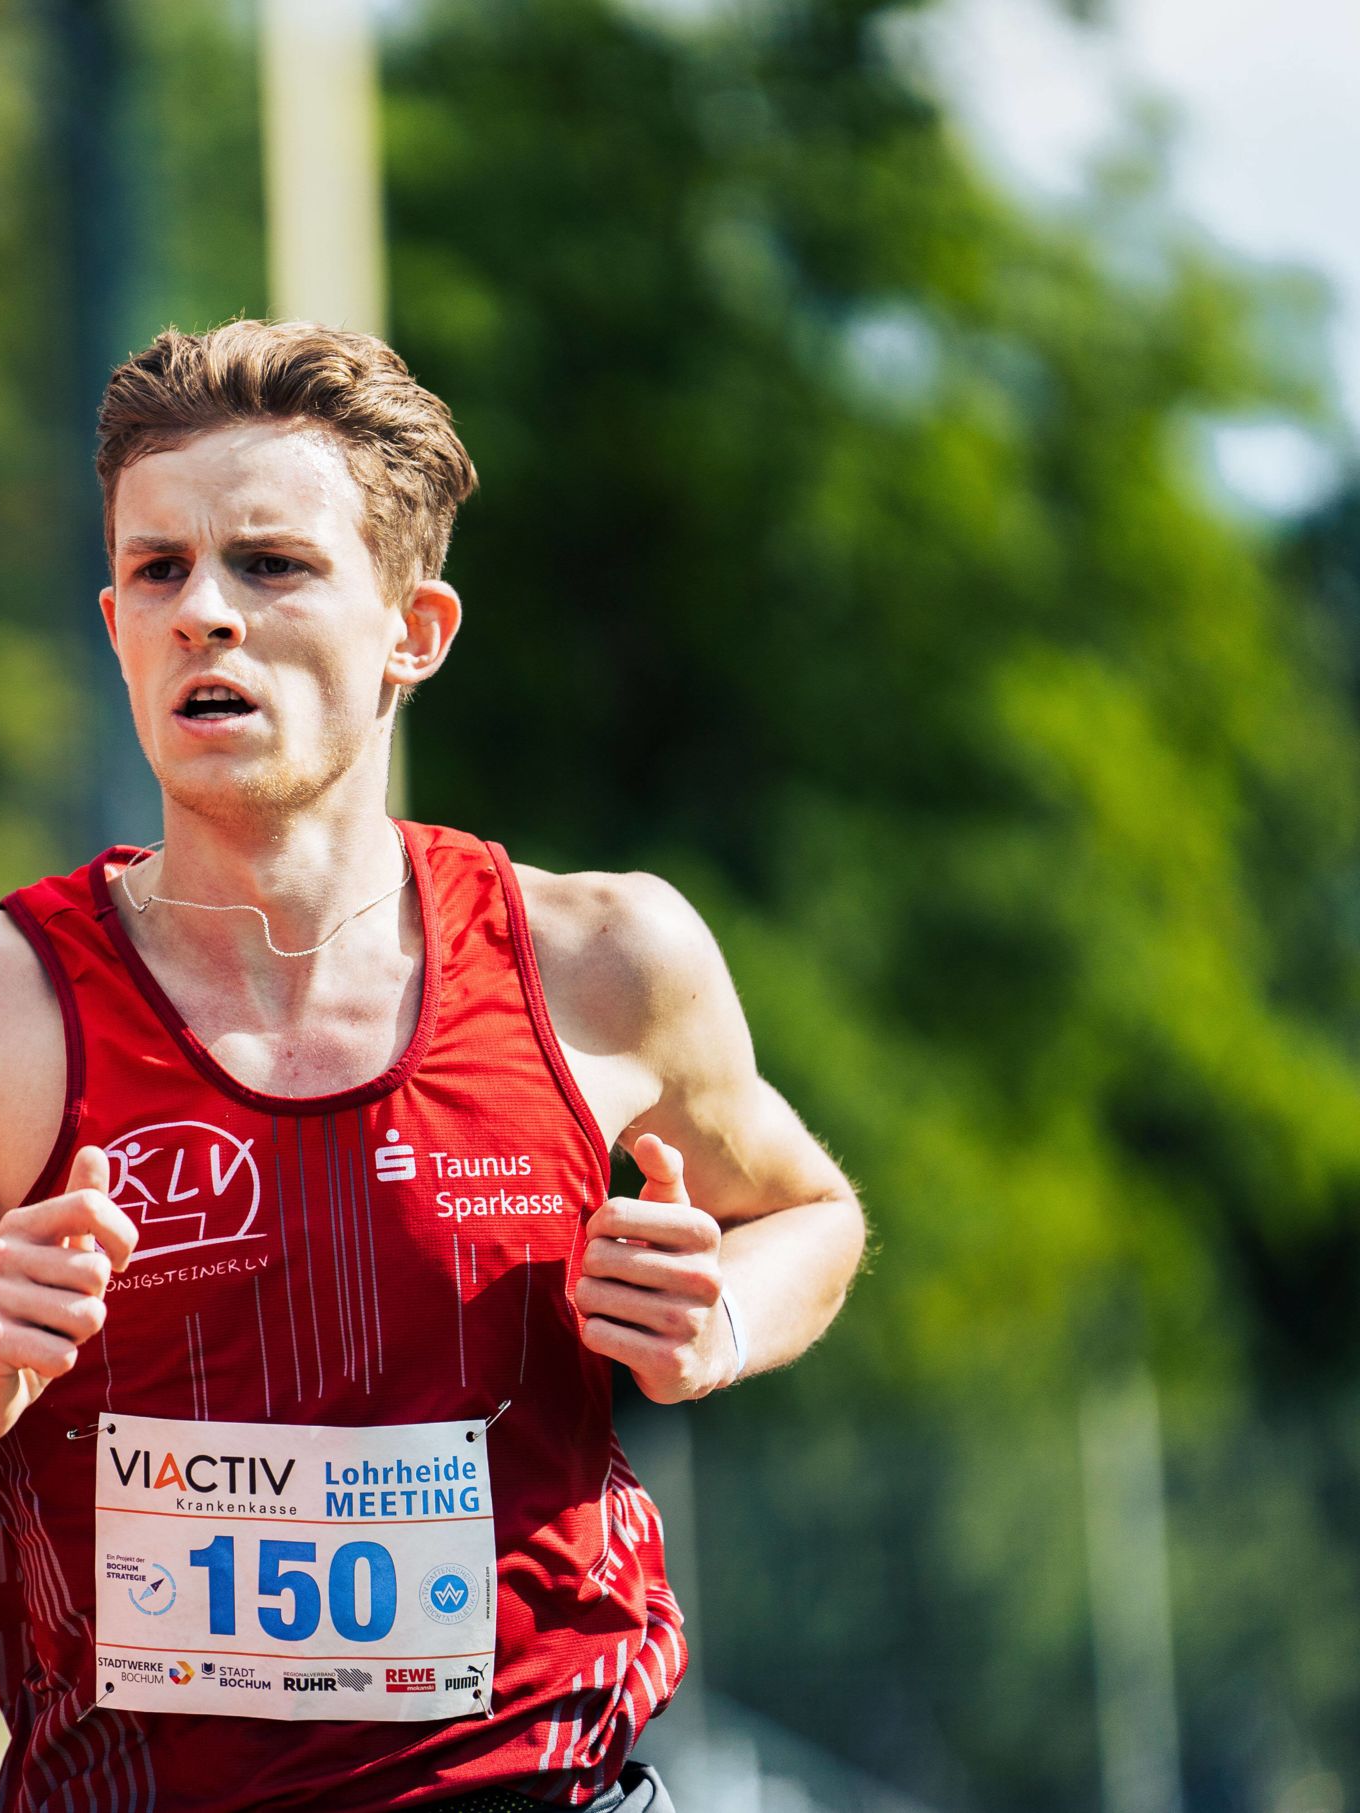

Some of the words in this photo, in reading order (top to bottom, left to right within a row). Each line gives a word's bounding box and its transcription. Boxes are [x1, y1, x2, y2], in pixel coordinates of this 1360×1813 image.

[429, 1152, 532, 1179] Taunus
[436, 1188, 564, 1223] Sparkasse
[104, 1258, 241, 1293] ÖNIGSTEINER
[109, 1447, 296, 1496] VIACTIV
[325, 1455, 477, 1486] Lohrheide
[176, 1498, 297, 1516] Krankenkasse
[325, 1486, 481, 1518] MEETING
[106, 1562, 139, 1572] BOCHUM
[106, 1571, 147, 1582] STRATEGIE
[189, 1535, 398, 1643] 150
[98, 1657, 164, 1672] STADTWERKE
[219, 1667, 256, 1678] STADT
[121, 1672, 165, 1685] BOCHUM
[385, 1668, 436, 1683] REWE
[445, 1675, 479, 1691] PUMA
[219, 1678, 272, 1690] BOCHUM
[283, 1677, 338, 1691] RUHR
